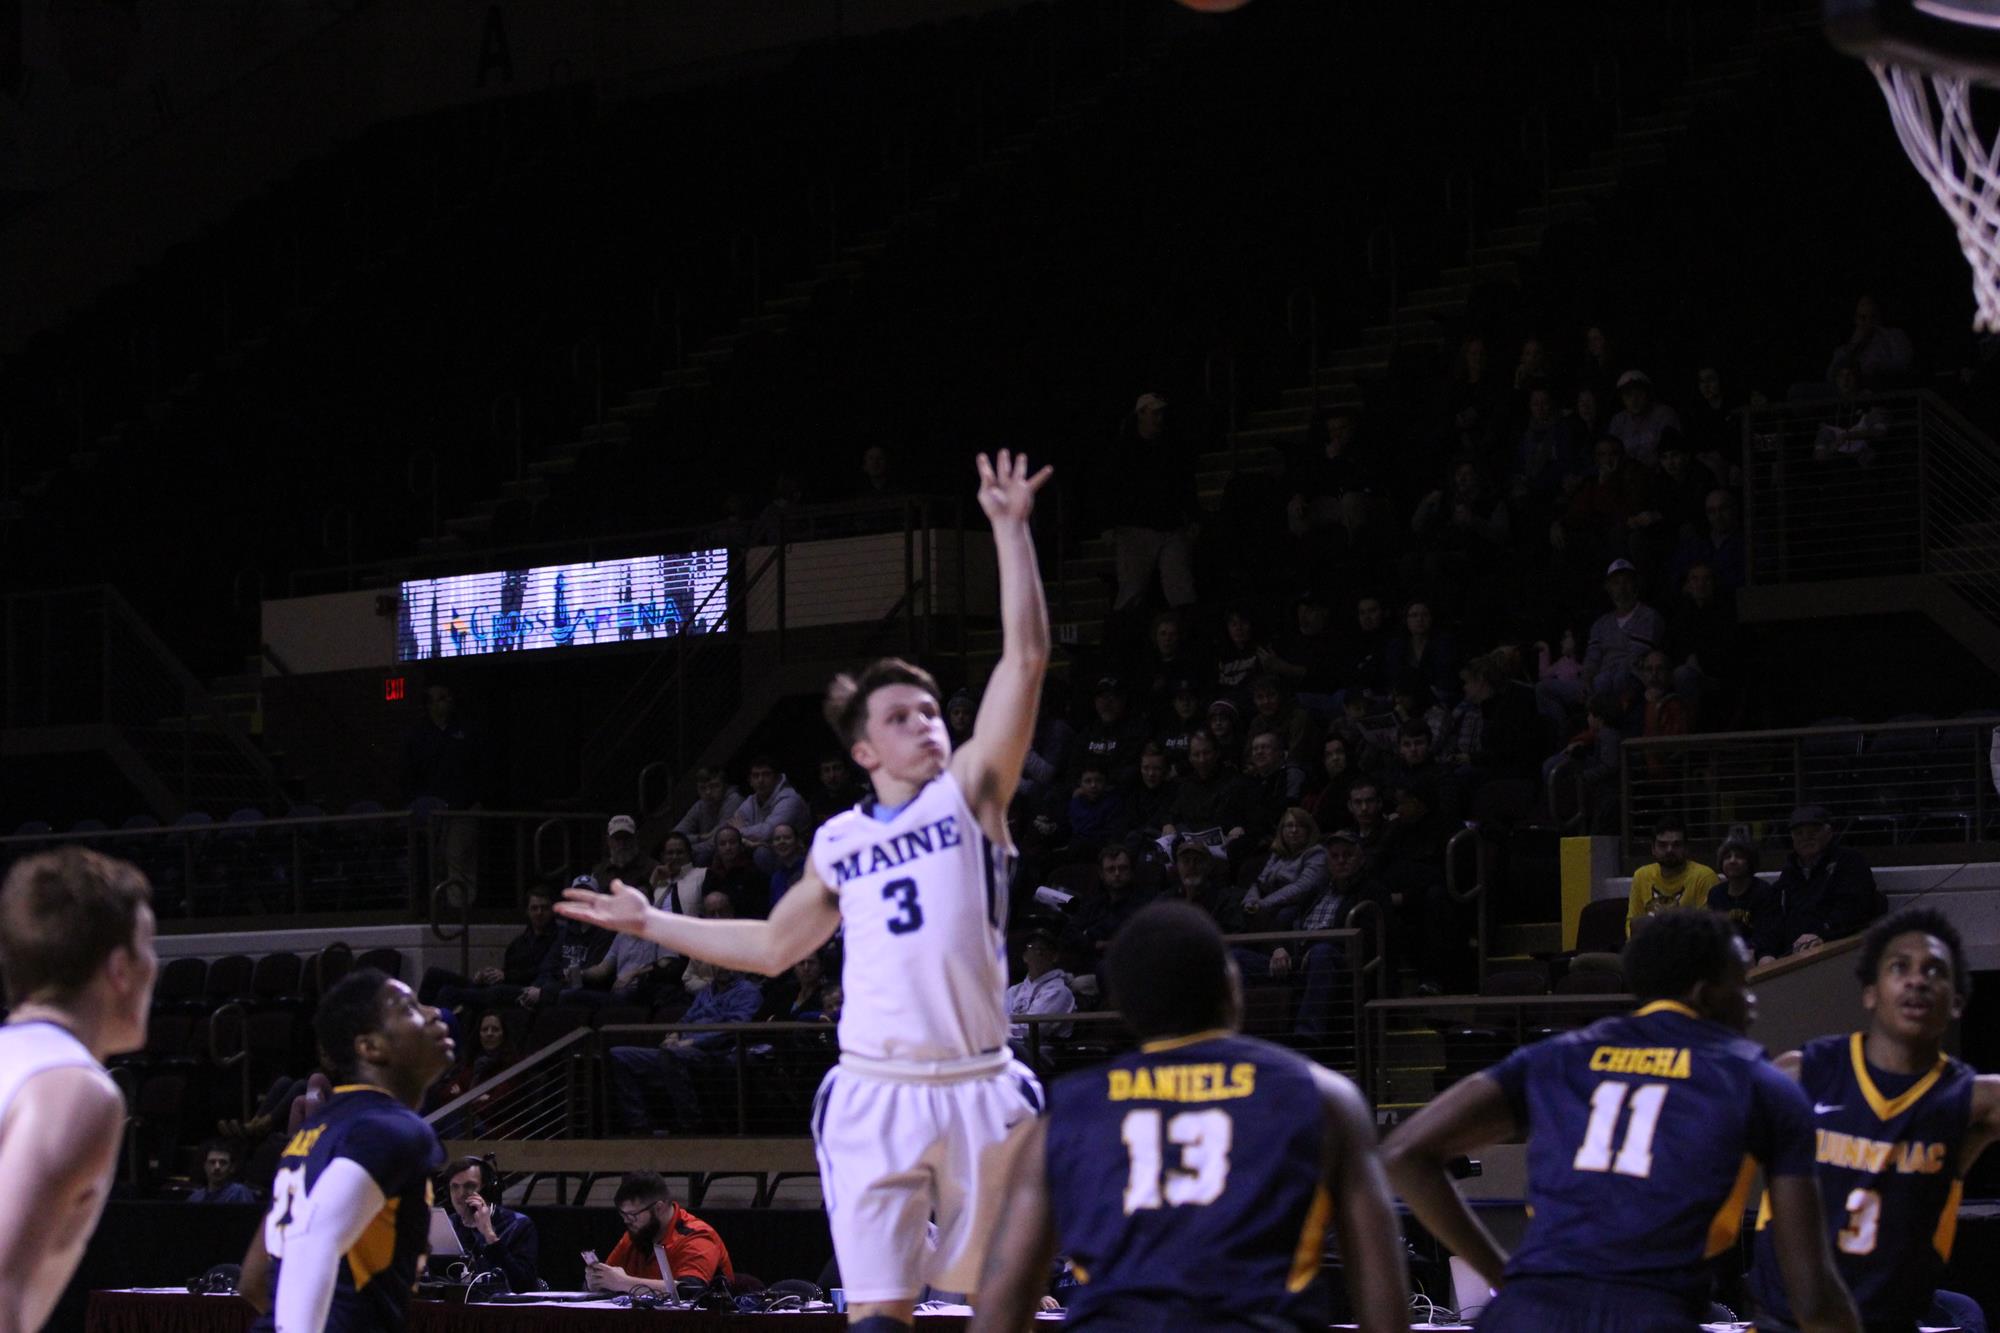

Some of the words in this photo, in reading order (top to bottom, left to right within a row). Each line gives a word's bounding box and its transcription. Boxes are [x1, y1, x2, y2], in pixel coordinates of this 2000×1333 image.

[573, 597, 682, 638] ARENA
[385, 677, 405, 701] EXIT
[832, 815, 961, 885] MAINE
[882, 876, 924, 936] 3
[1108, 1062, 1256, 1102] DANIELS
[1573, 1080, 1669, 1178] 11
[1121, 1107, 1233, 1216] 13
[1838, 1188, 1882, 1255] 3
